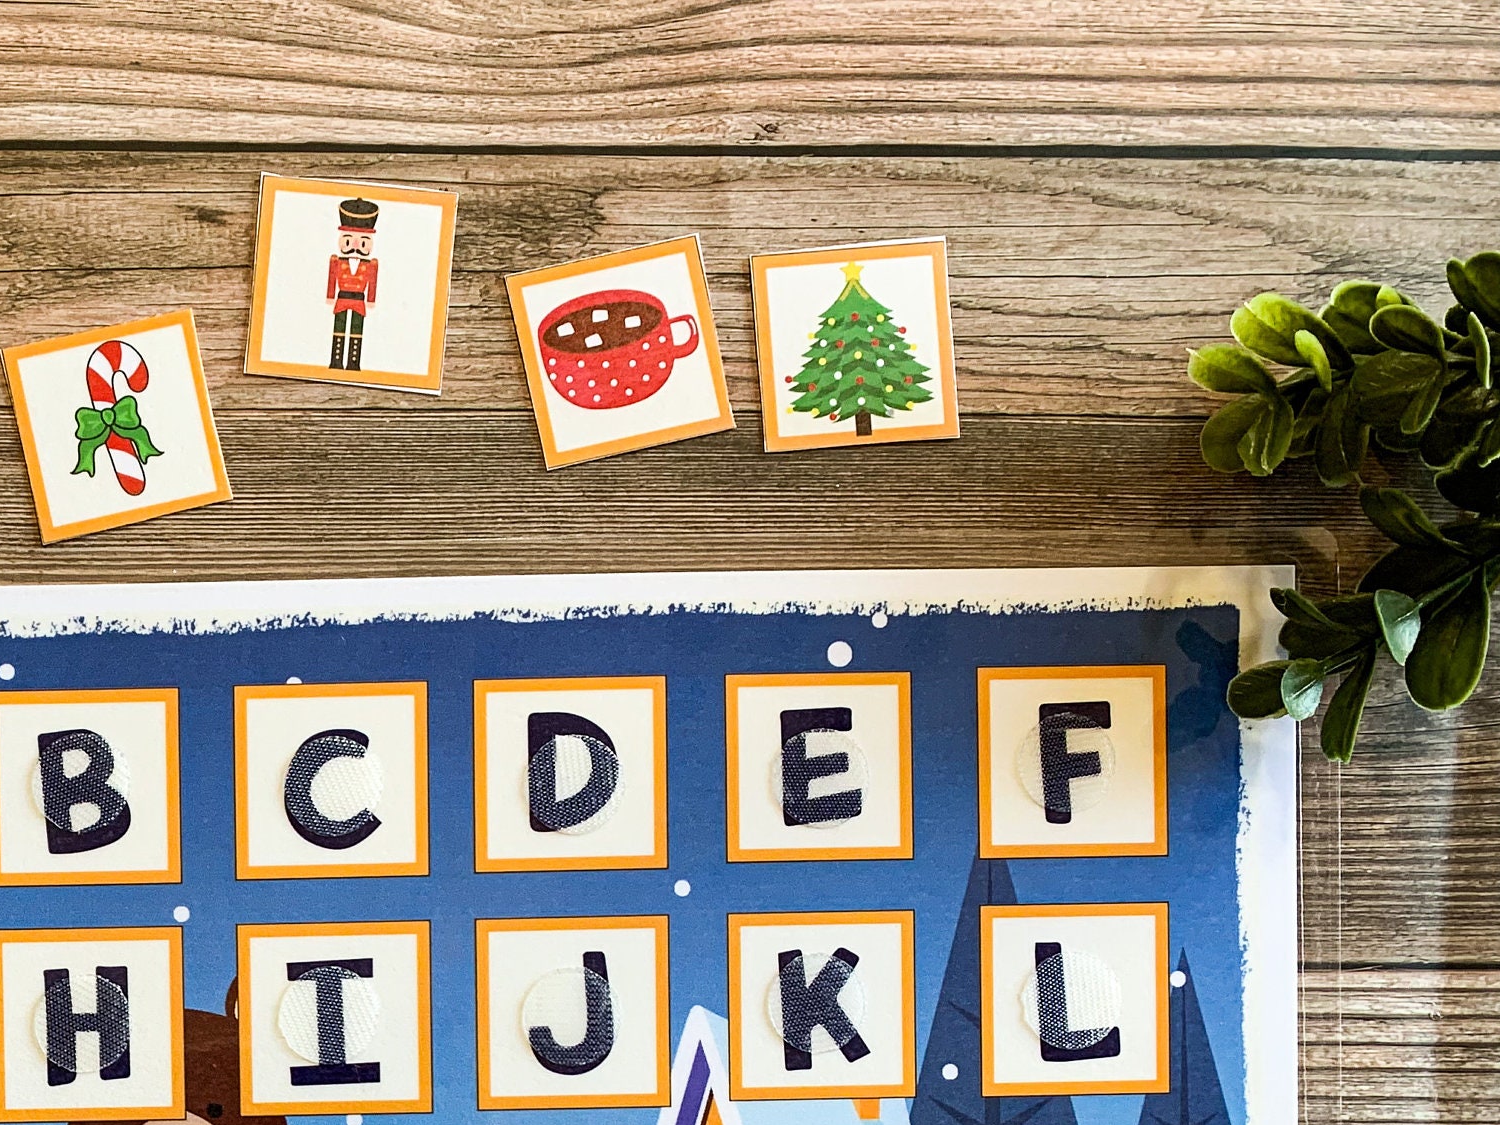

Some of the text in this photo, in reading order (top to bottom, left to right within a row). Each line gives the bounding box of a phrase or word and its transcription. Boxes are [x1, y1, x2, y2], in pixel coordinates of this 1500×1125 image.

[38, 729, 131, 854] B
[284, 729, 381, 850] C
[528, 712, 619, 832] D
[780, 707, 862, 826] E
[1039, 701, 1111, 824] F
[44, 966, 130, 1086] H
[287, 958, 380, 1086] I
[529, 952, 613, 1075] J
[778, 948, 870, 1071] K
[1035, 942, 1120, 1062] L
